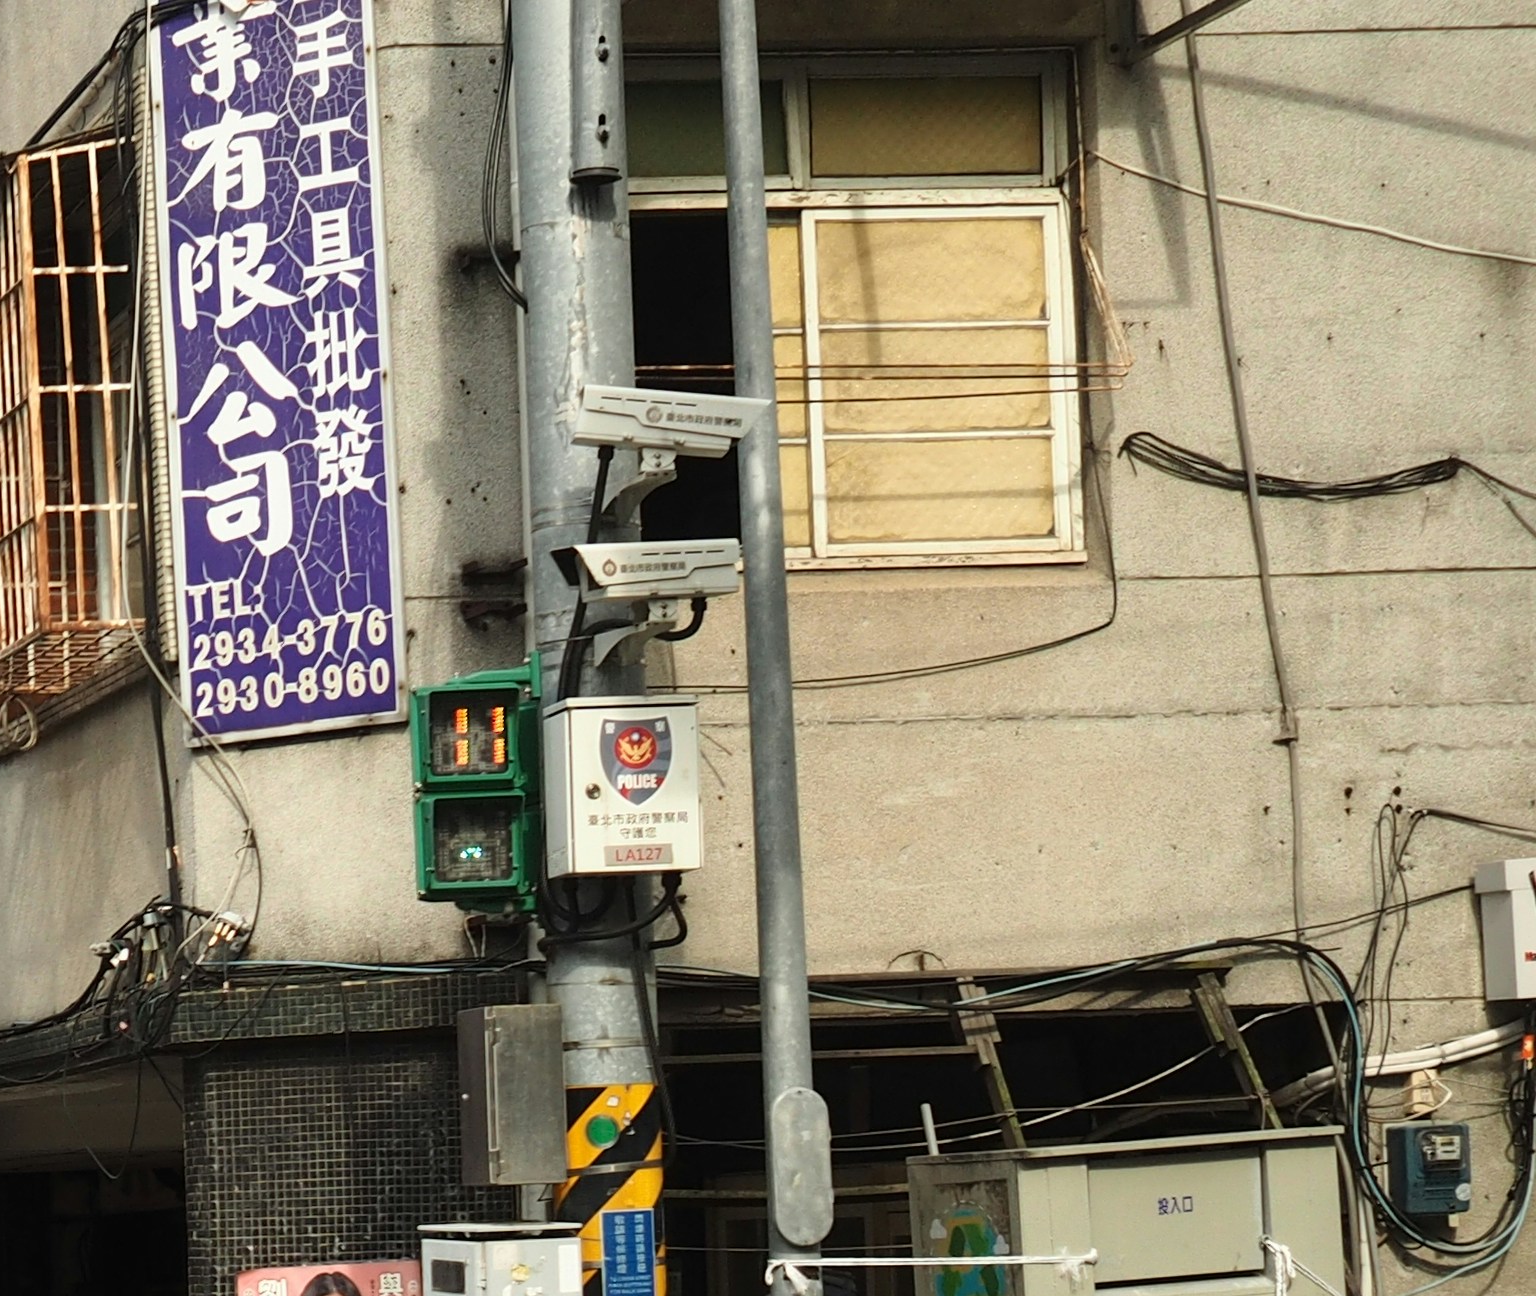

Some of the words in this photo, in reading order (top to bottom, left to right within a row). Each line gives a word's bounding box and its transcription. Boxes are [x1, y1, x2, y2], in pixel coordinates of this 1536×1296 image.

[293, 10, 375, 496] 手工具批發
[187, 578, 263, 622] TEL:
[193, 608, 387, 670] 2934-3776
[196, 658, 389, 718] 2930-8960
[617, 774, 658, 790] POLICE
[588, 811, 688, 826] 臺北市政府警察局
[615, 847, 662, 863] LA127
[1157, 1196, 1194, 1216] 投入口
